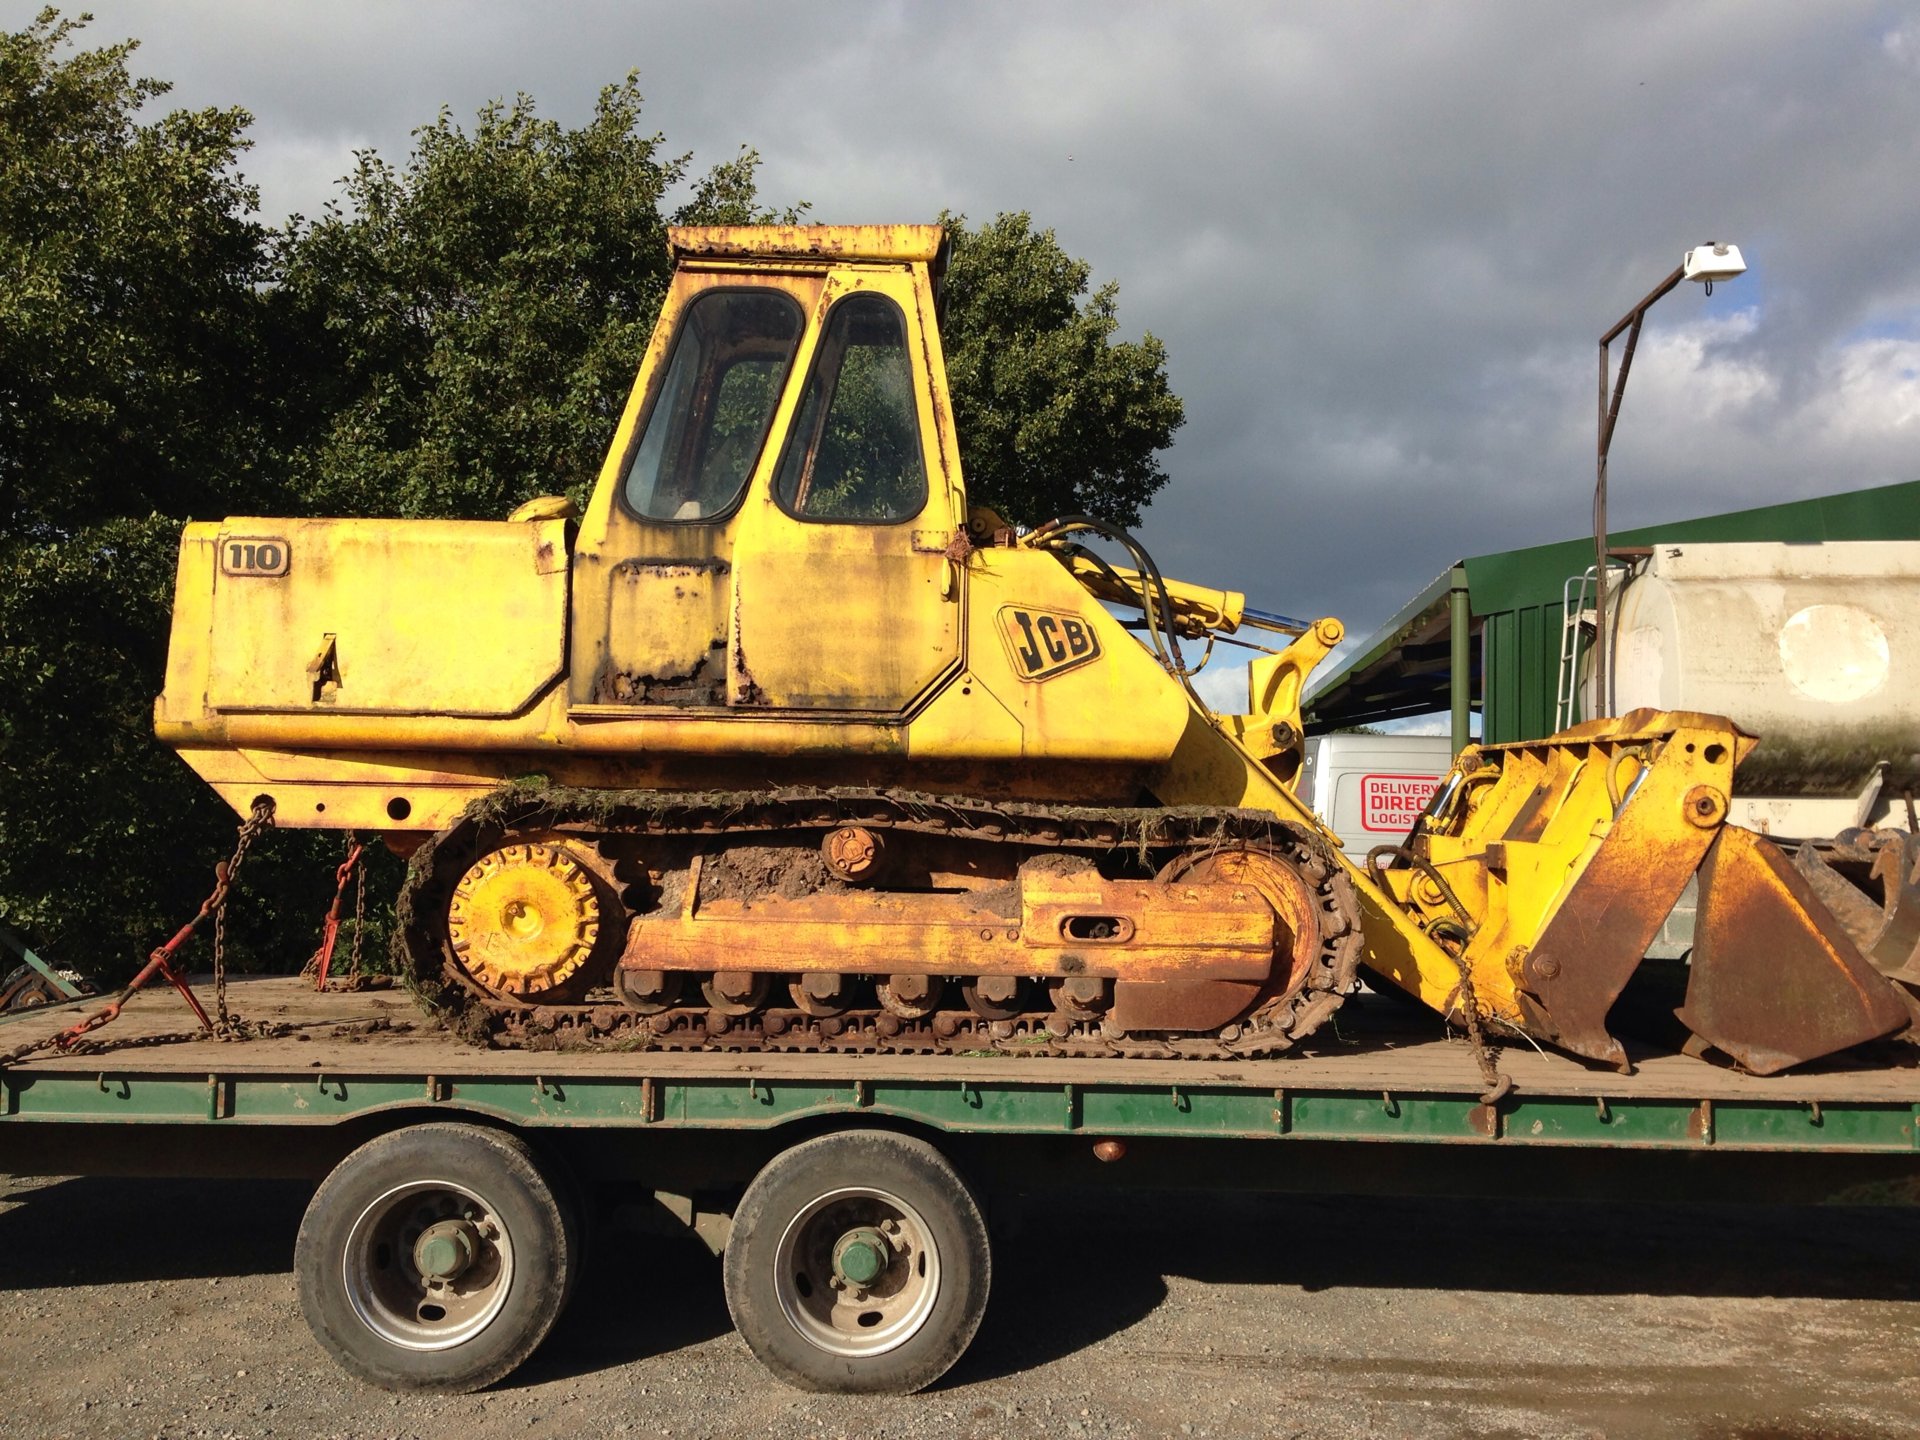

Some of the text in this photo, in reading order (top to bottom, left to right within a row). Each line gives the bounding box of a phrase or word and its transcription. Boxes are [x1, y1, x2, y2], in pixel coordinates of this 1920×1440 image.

[229, 544, 282, 571] 110
[1013, 610, 1089, 674] JCB
[1370, 782, 1440, 795] DELIVERY
[1371, 795, 1433, 812] DIREC
[1371, 812, 1419, 825] LOGIST
